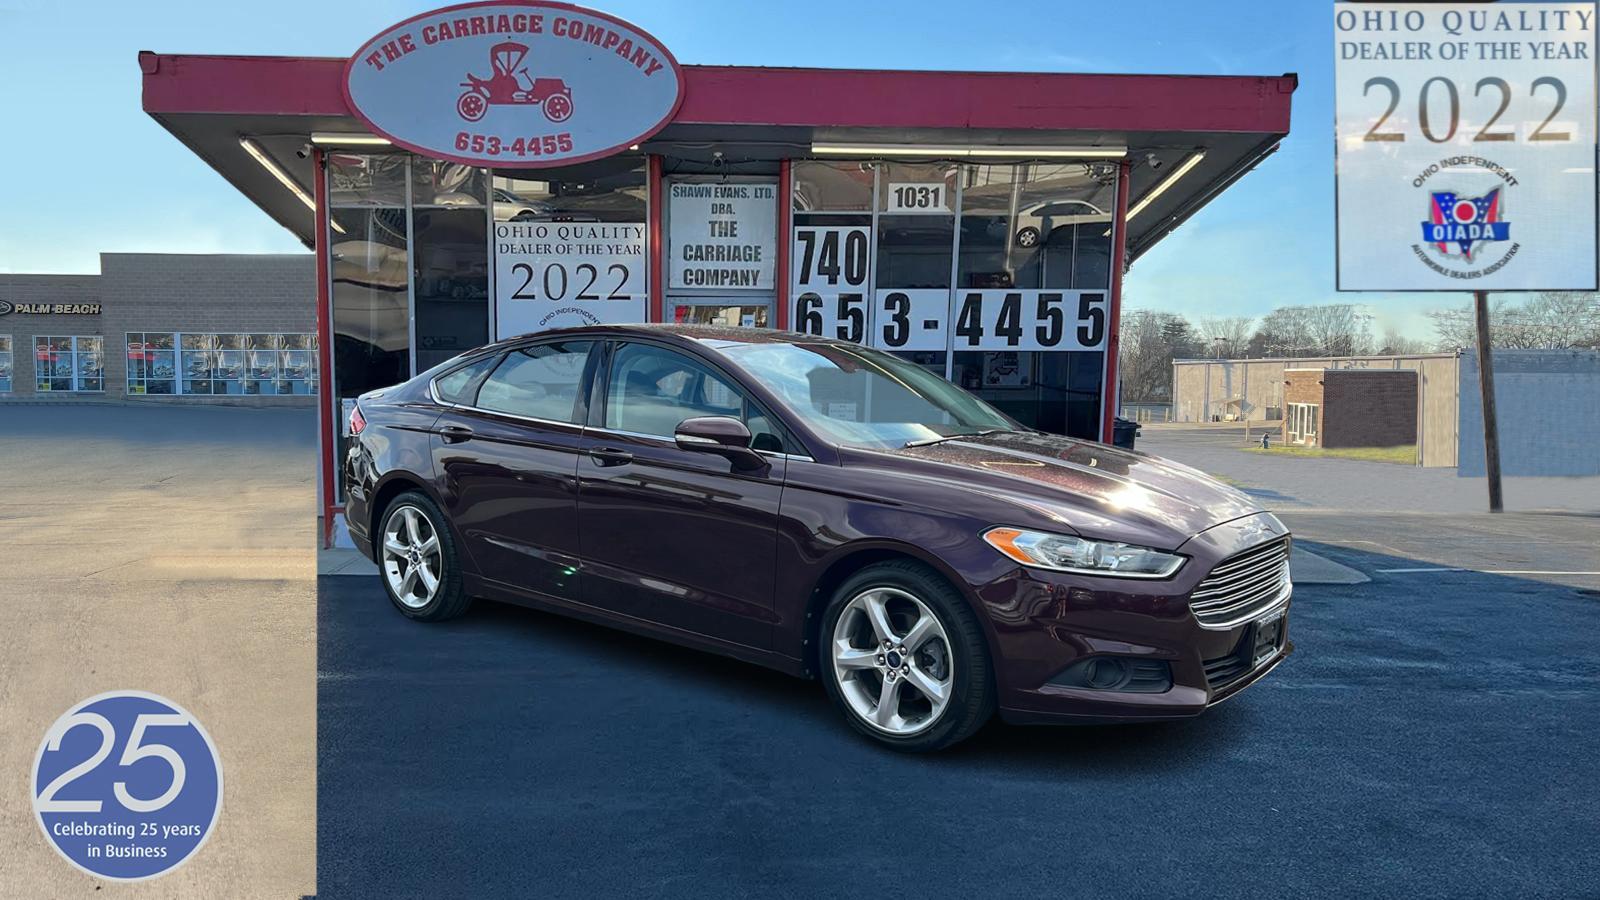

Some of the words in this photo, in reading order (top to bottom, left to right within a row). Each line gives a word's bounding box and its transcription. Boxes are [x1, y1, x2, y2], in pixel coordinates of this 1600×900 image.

[1336, 10, 1425, 32] OHIO
[1442, 10, 1593, 36] QUALITY
[366, 34, 416, 71] THE
[422, 14, 543, 45] CARRIAGE
[553, 17, 664, 77] COMPANY
[1340, 41, 1432, 60] DEALER
[1439, 41, 1470, 60] OF
[1475, 41, 1522, 60] THE
[1528, 41, 1589, 60] YEAR
[1363, 76, 1571, 143] 2022
[455, 131, 573, 157] 653-4455
[1412, 163, 1440, 188] OHIO
[1440, 155, 1519, 187] INDEPENDENT
[672, 186, 712, 199] SHAWN
[754, 187, 775, 199] LTD.
[894, 186, 940, 208] 1031
[711, 203, 736, 215] DBA.
[496, 225, 549, 239] OHIO
[558, 225, 645, 241] QUALITY
[708, 221, 738, 238] THE
[1432, 224, 1496, 241] OIADA
[499, 243, 552, 256] DEALER
[555, 243, 574, 256] OF
[576, 243, 603, 256] THE
[605, 243, 642, 256] YEAR
[683, 244, 762, 263] CARRIAGE
[797, 230, 868, 286] 740
[510, 262, 632, 301] 2022
[683, 268, 761, 287] COMPANY
[1449, 270, 1482, 280] DEALERS
[14, 303, 51, 315] PALM
[54, 304, 100, 315] BEACH
[539, 312, 555, 326] OHIO
[555, 307, 601, 326] INDEPENDENT
